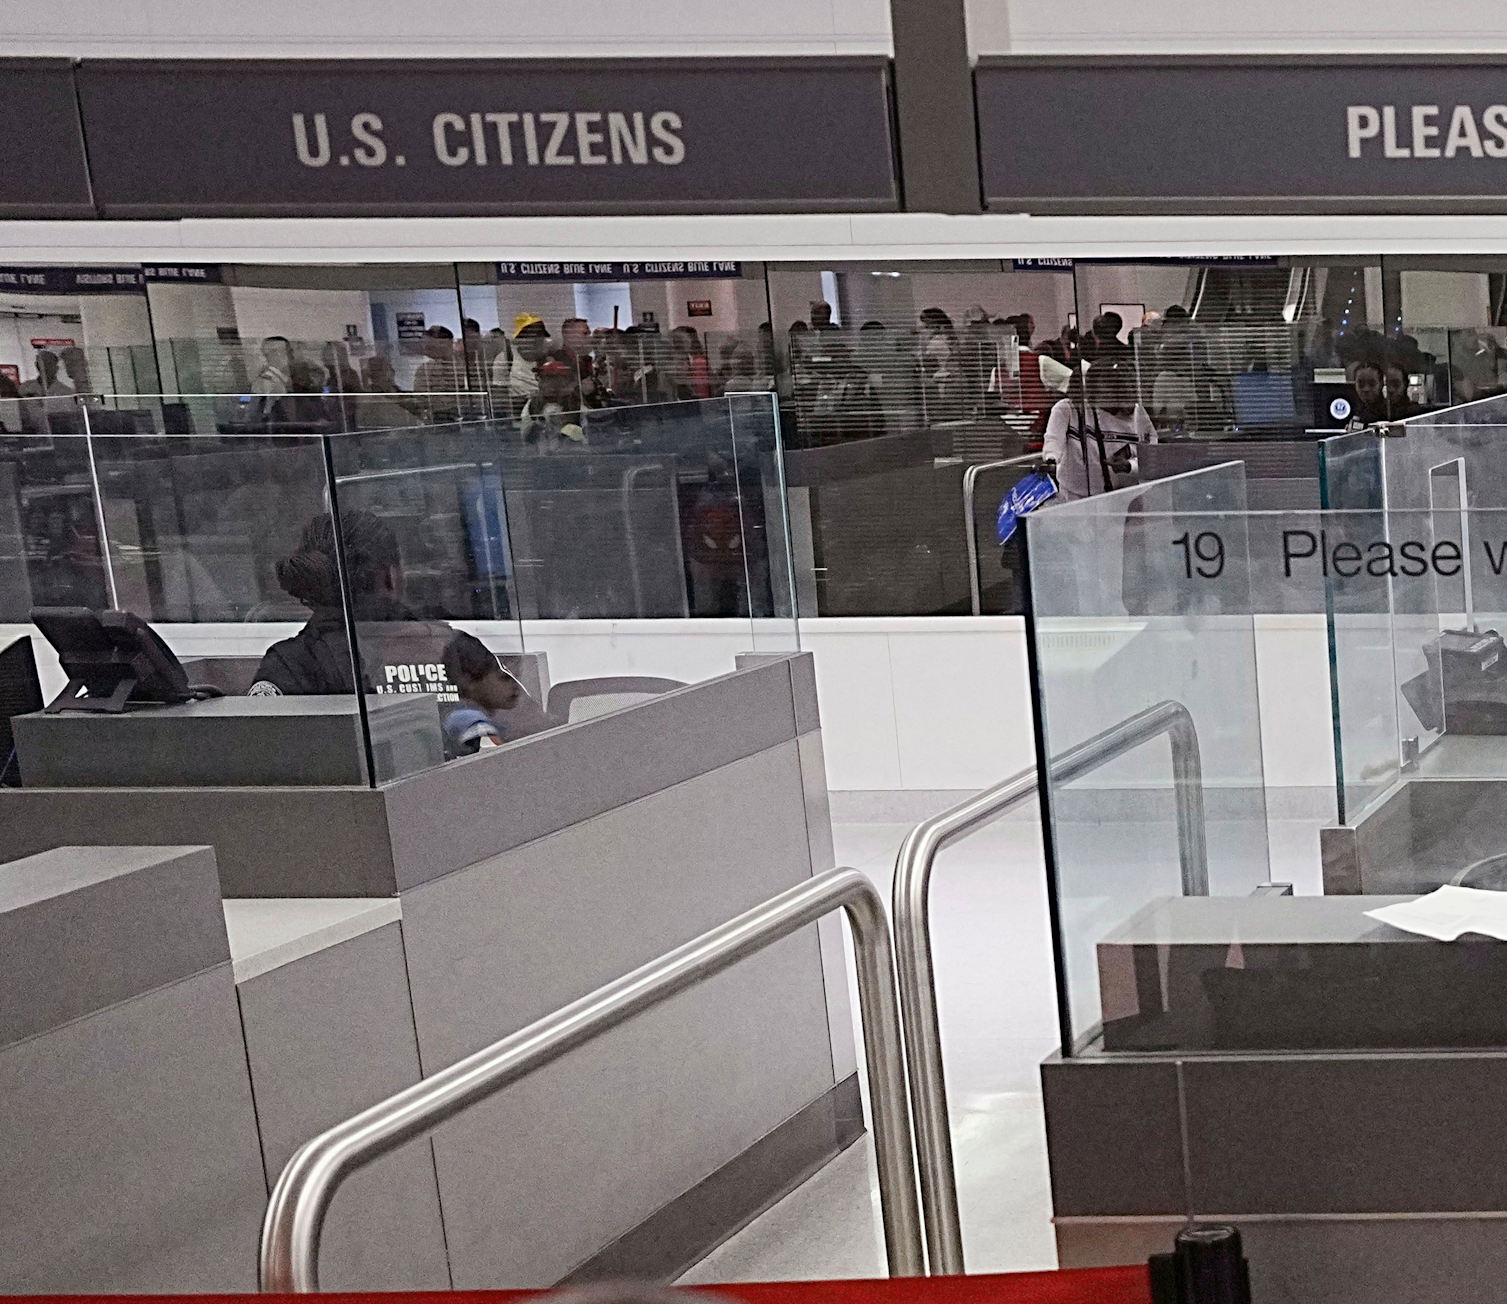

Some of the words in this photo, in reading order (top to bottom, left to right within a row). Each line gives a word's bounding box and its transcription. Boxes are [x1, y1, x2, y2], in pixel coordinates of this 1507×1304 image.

[292, 112, 406, 167] U.S.
[432, 111, 686, 167] CITIZENS
[1172, 531, 1226, 579] 19
[1282, 529, 1463, 578] Please
[376, 684, 397, 694] U.S.
[384, 664, 448, 683] POLICE
